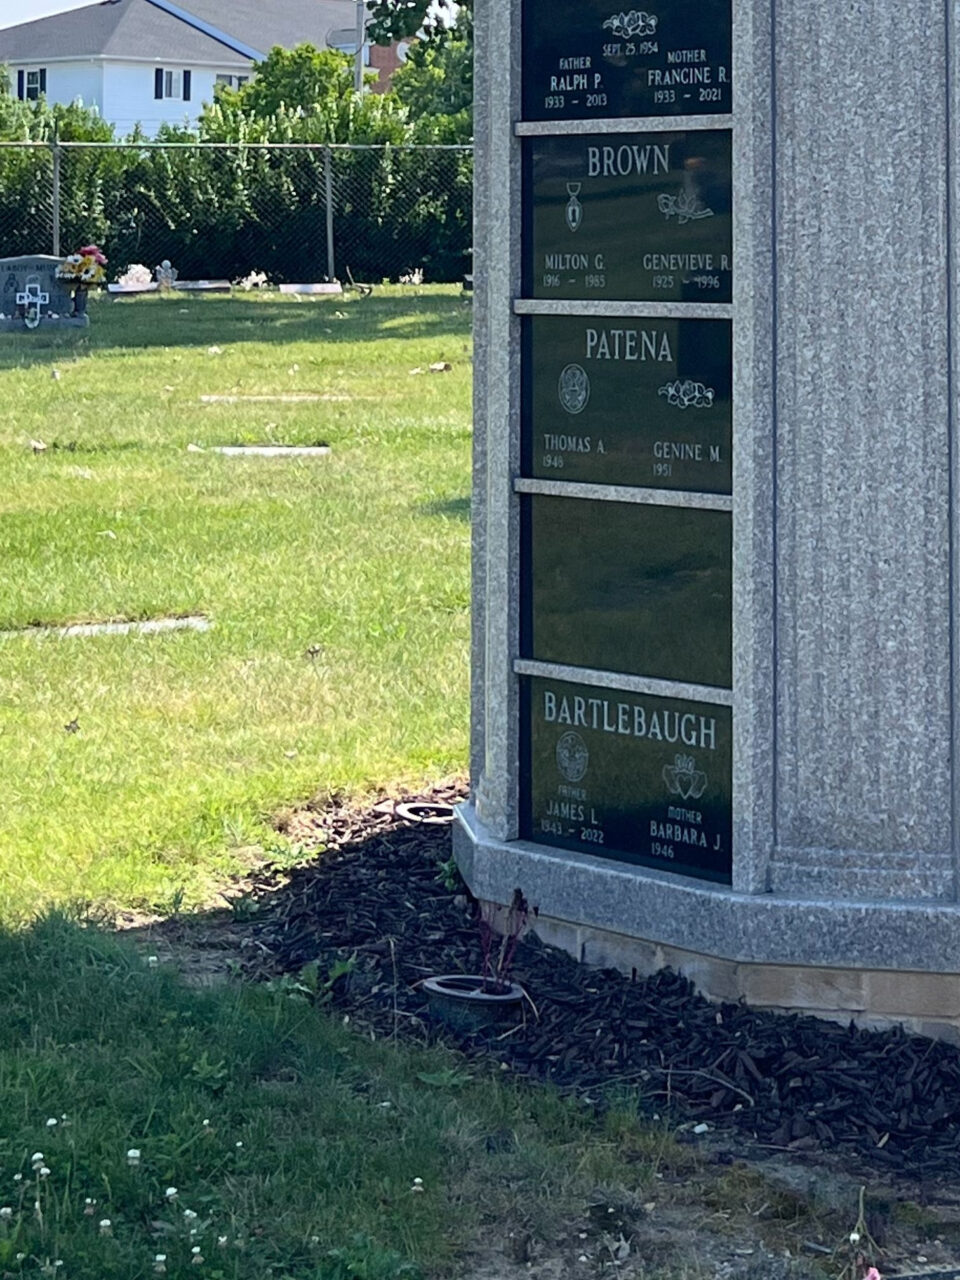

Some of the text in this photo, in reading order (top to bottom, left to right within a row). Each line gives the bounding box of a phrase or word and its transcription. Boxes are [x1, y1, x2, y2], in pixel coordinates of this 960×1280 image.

[559, 57, 592, 70] FATHER
[667, 49, 707, 63] MOTHER
[550, 74, 588, 92] RALPH
[648, 67, 711, 86] FRANCINE
[545, 95, 565, 109] 1933
[586, 94, 607, 107] 2013
[654, 90, 676, 103] 1933
[699, 88, 722, 101] 2021
[588, 144, 670, 177] BROWN
[545, 254, 589, 270] MILTON
[643, 254, 713, 270] GENEVIEVE
[652, 275, 674, 288] 1925
[586, 329, 673, 362] PATENA
[544, 434, 591, 453] THOMAS
[654, 441, 702, 461] GENINE
[653, 463, 671, 477] 1951
[544, 691, 716, 750] BARTLEBAUGH
[558, 785, 587, 801] FATHER
[547, 803, 584, 821] JAMES
[668, 806, 702, 824] MOTHER
[541, 819, 562, 835] 1943
[581, 827, 604, 844] 2022
[650, 821, 707, 847] BARBARA
[651, 843, 674, 858] 1946
